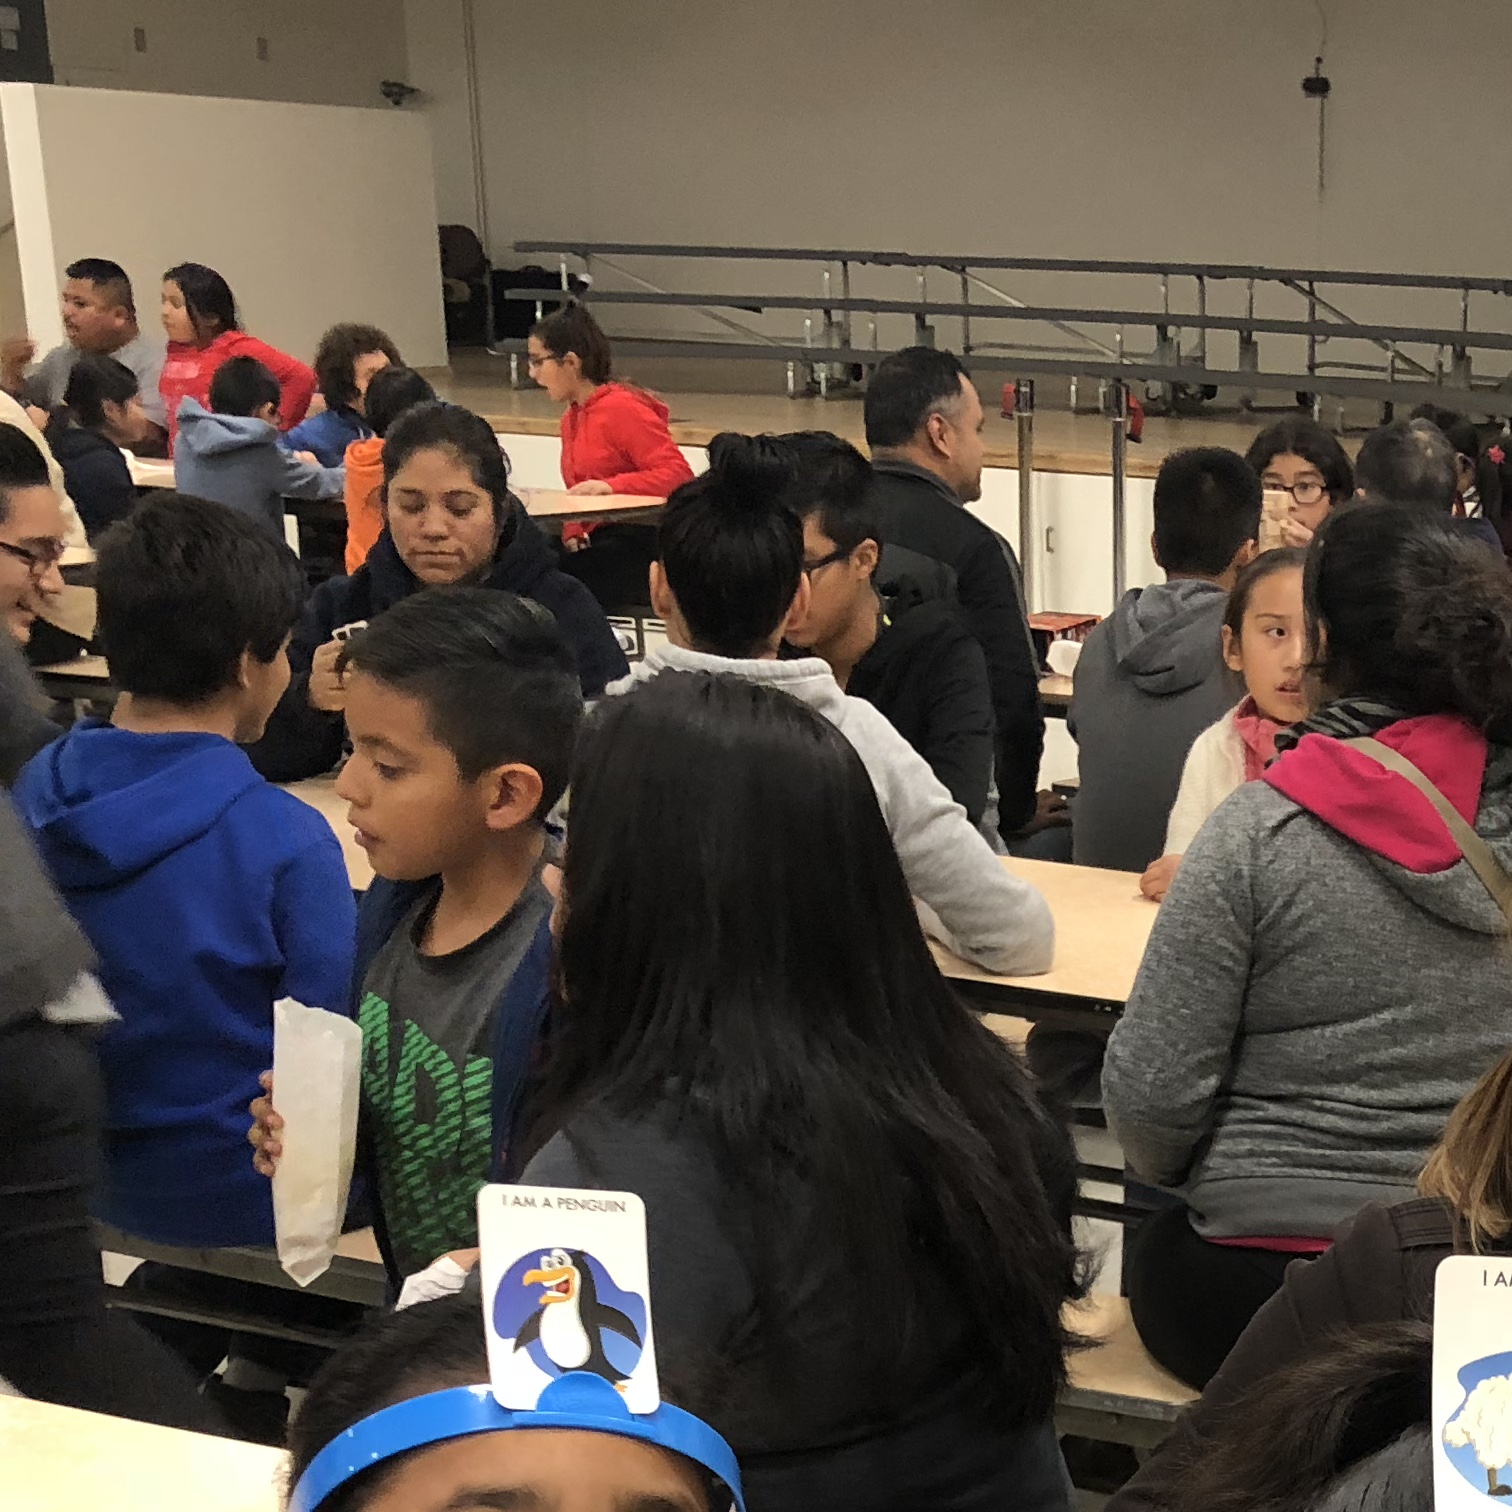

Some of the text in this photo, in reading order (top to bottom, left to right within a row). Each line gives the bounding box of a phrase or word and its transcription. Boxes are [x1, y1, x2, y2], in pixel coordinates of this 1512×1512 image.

[502, 1194, 626, 1212] I AM A PENGUIN
[1482, 1269, 1487, 1287] I
